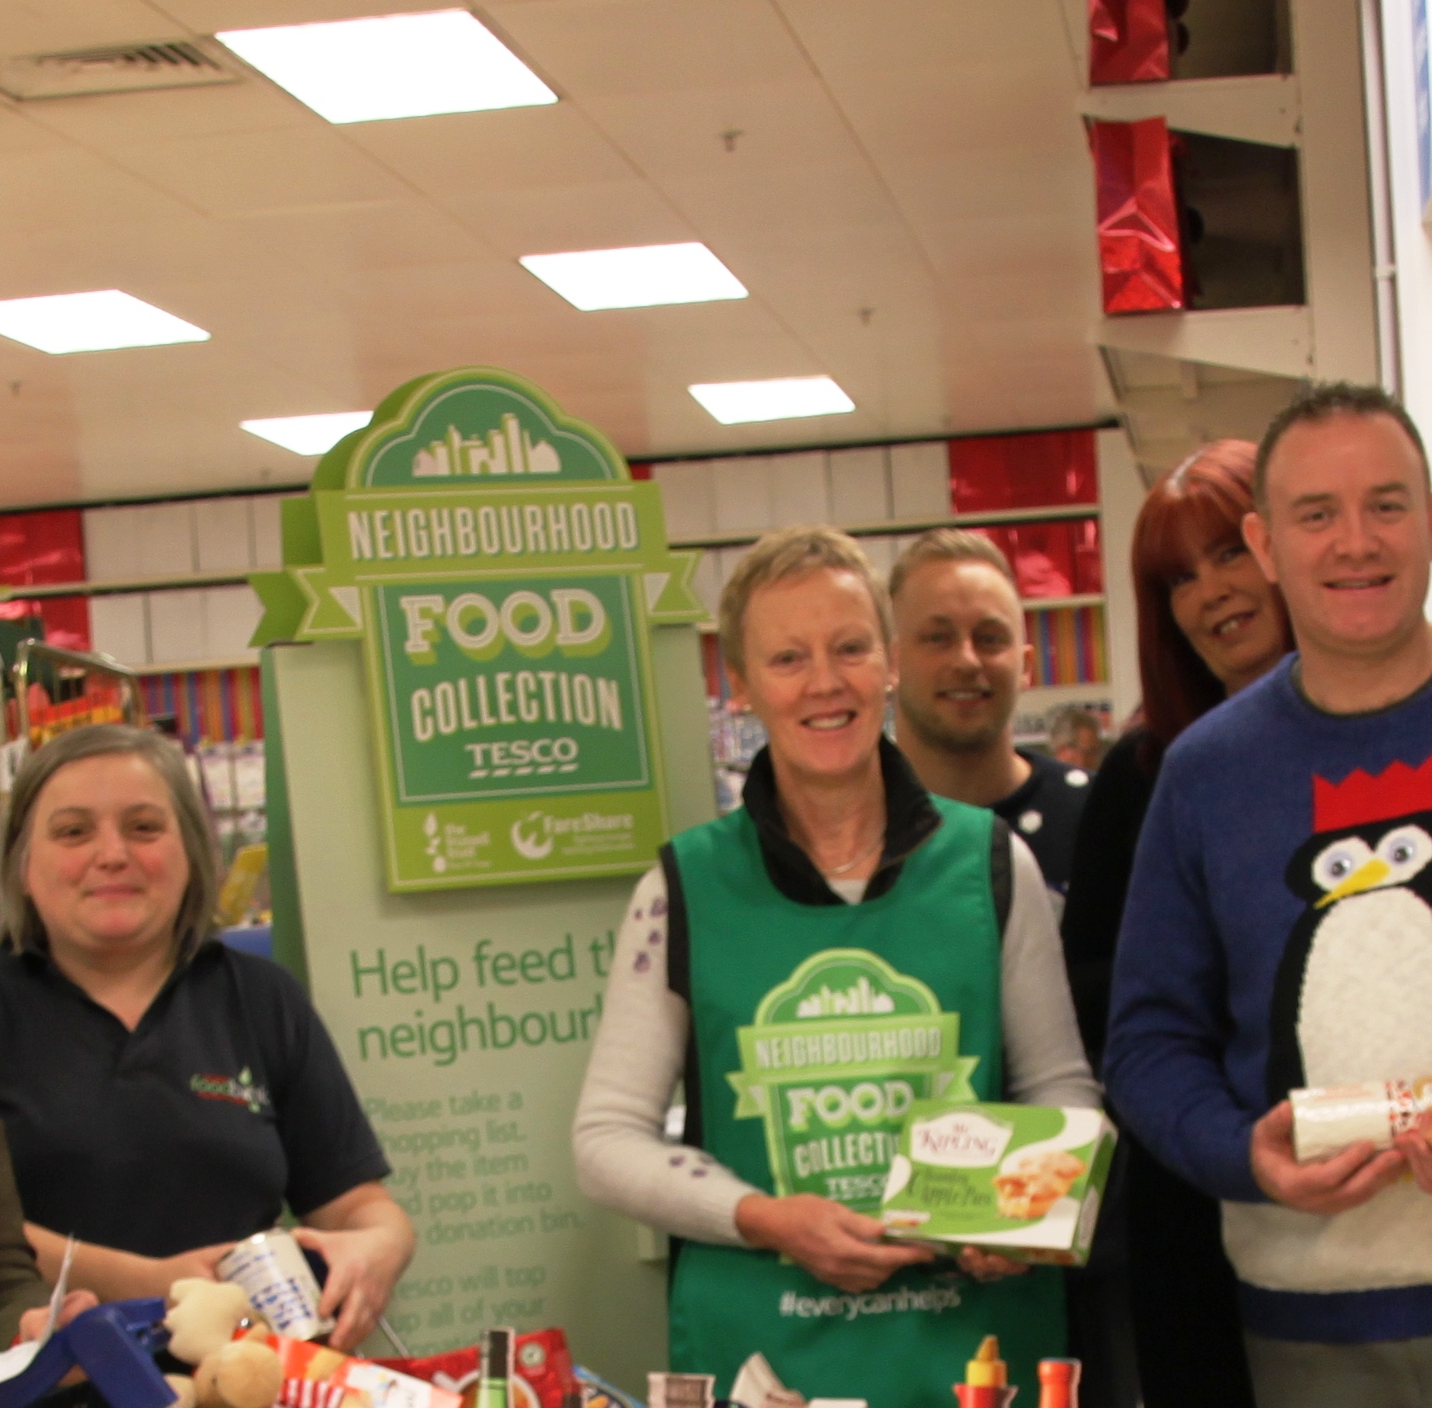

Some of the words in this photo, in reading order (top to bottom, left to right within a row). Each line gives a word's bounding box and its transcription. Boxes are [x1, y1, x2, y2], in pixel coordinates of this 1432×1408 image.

[347, 502, 639, 561] NEIGHBOURHOOD
[399, 588, 607, 655] FOOD
[411, 671, 623, 742] COLLECTION
[466, 738, 579, 767] TESCO
[350, 943, 460, 1003] Help
[473, 932, 577, 988] feed
[756, 1027, 942, 1069] NEIGHBOURHOOD
[449, 1088, 502, 1116] take
[508, 1091, 525, 1111] a
[786, 1080, 914, 1126] FOOD
[473, 1153, 529, 1177] item
[794, 1132, 899, 1178] COLLECTI
[430, 1191, 477, 1215] pop
[505, 1180, 553, 1203] into
[826, 1176, 888, 1200] TESC
[426, 1215, 534, 1246] donation
